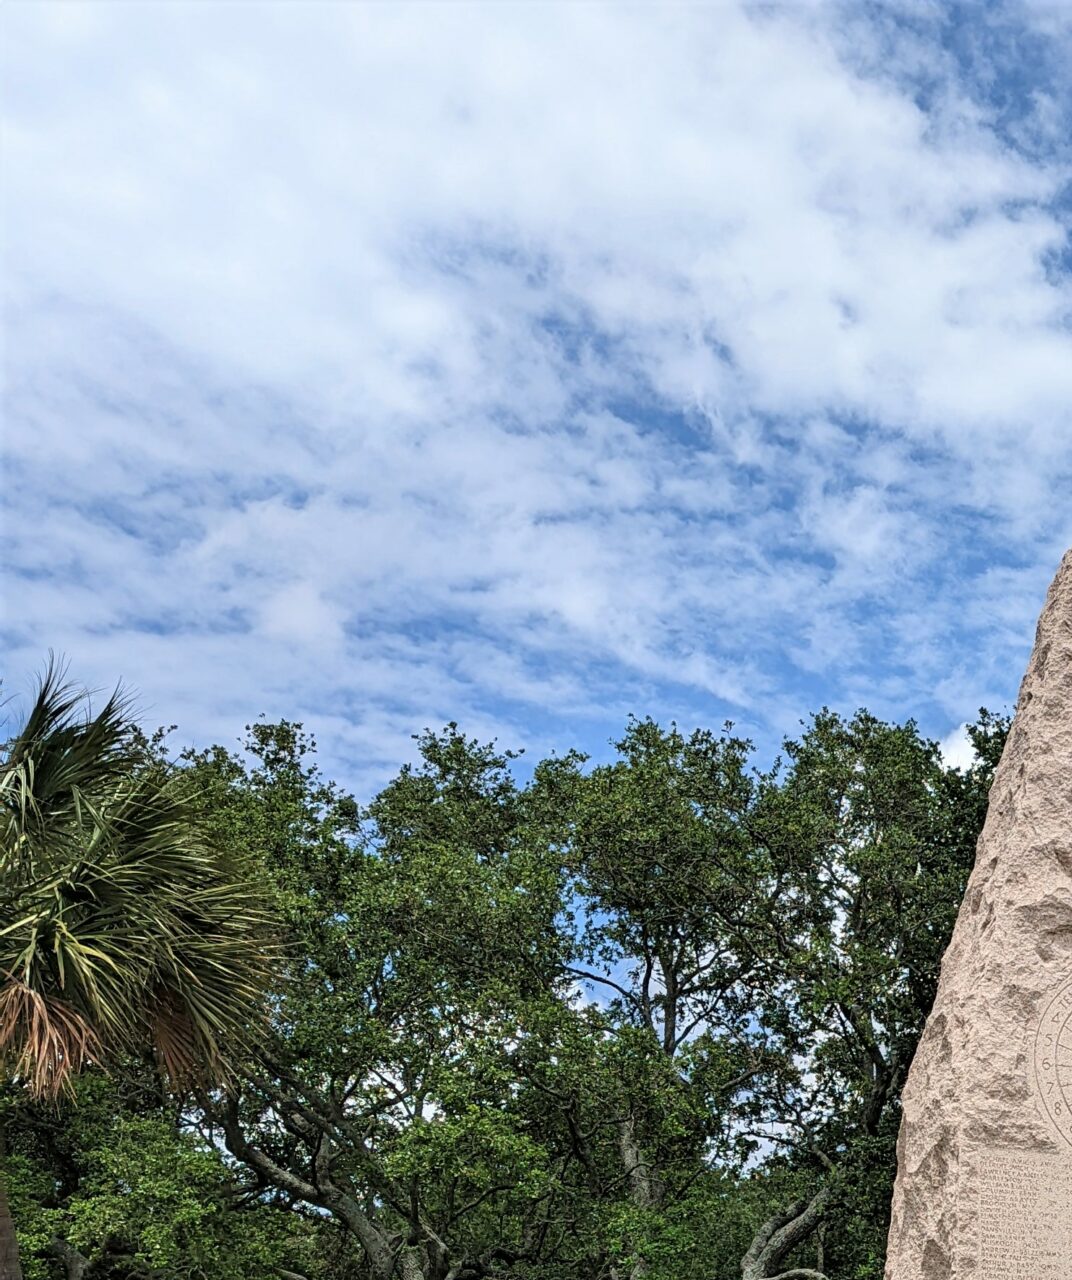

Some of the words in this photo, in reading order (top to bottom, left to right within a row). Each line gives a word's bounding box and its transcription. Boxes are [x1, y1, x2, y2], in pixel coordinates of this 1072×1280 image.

[1044, 1033, 1053, 1047] 5
[1041, 1057, 1050, 1071] 6
[1045, 1082, 1054, 1094] 7
[1054, 1101, 1062, 1116] 8
